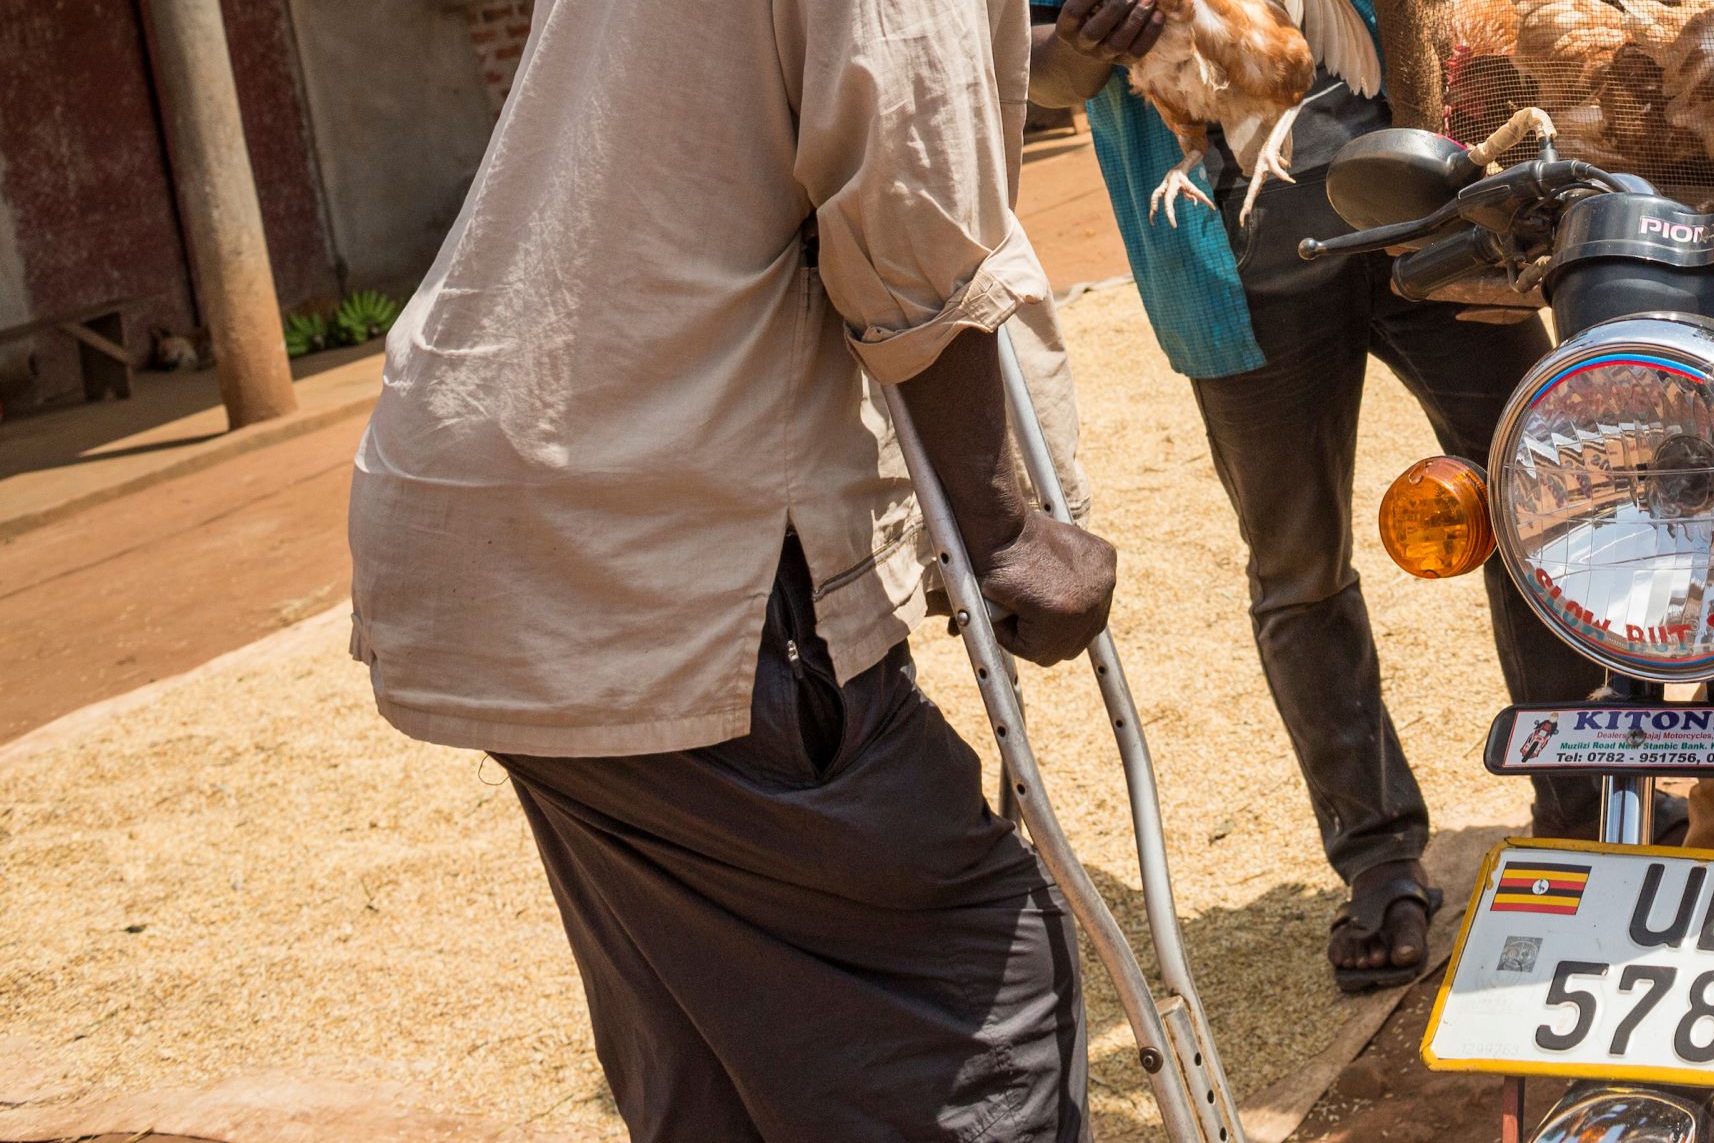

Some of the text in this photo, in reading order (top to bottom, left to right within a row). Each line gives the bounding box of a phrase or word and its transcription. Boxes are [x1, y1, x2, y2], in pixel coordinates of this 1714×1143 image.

[1625, 623, 1692, 652] BUT
[1597, 731, 1628, 739] Dealers
[1663, 731, 1714, 741] Motorcycles,
[1592, 741, 1616, 750] Road
[1643, 742, 1678, 750] Stanbic
[1556, 752, 1582, 763] Tel:
[1587, 752, 1626, 763] 0782
[1639, 753, 1701, 765] 951756,
